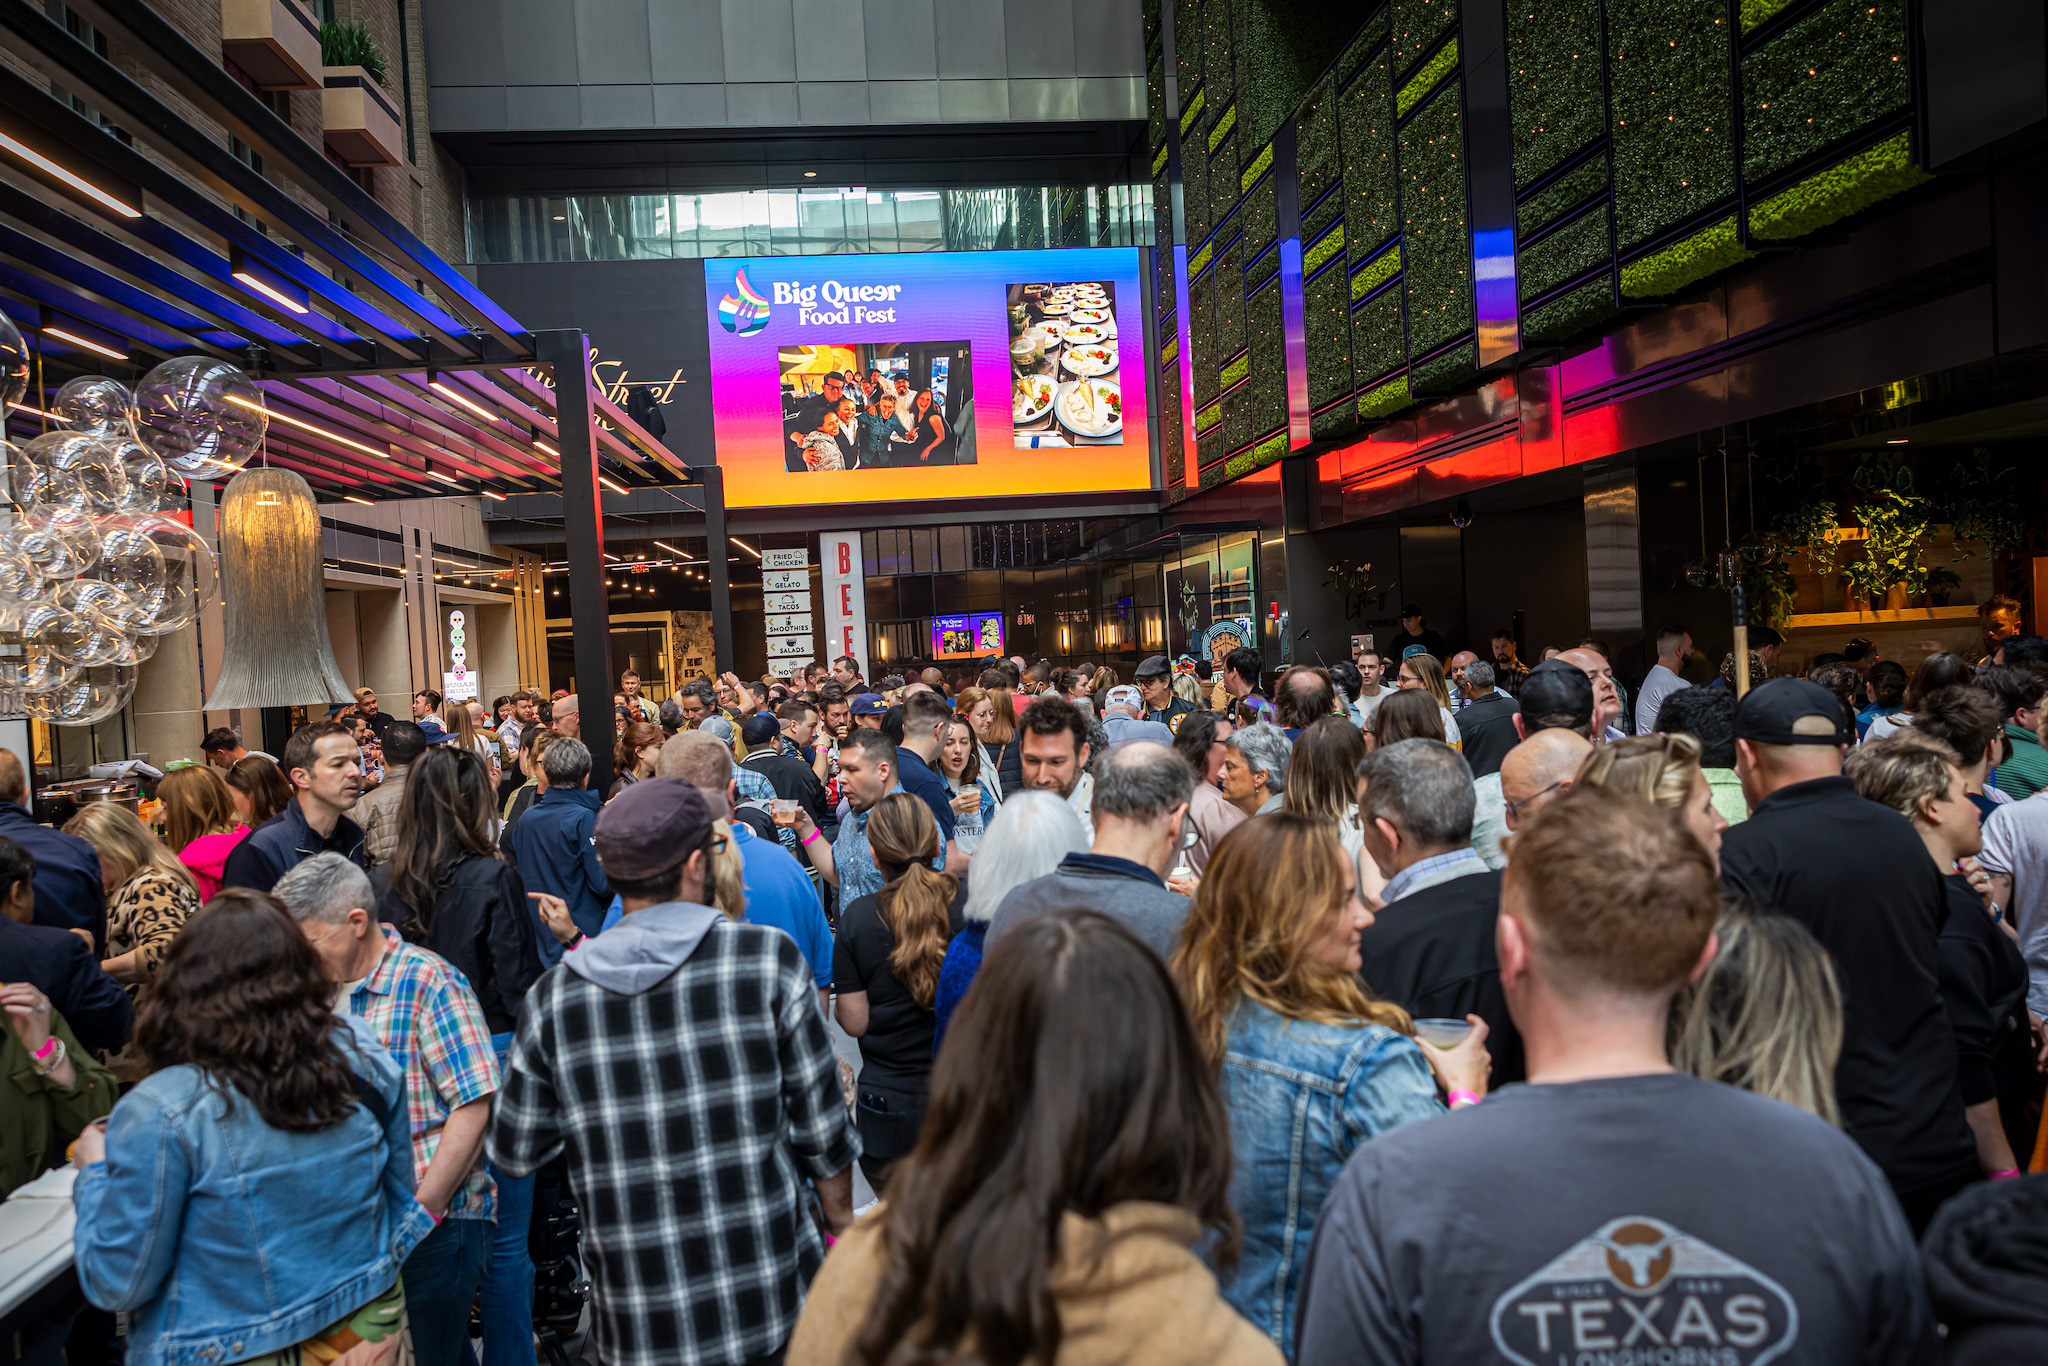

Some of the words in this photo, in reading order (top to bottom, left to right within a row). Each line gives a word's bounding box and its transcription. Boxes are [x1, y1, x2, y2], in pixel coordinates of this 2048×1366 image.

[772, 281, 818, 310] Big
[821, 280, 902, 309] Queer
[799, 306, 850, 326] Food
[854, 305, 897, 324] Fest
[591, 360, 687, 405] Stret
[834, 542, 855, 658] BEE
[953, 827, 985, 837] YSTER
[1517, 1294, 1769, 1352] TEXAS
